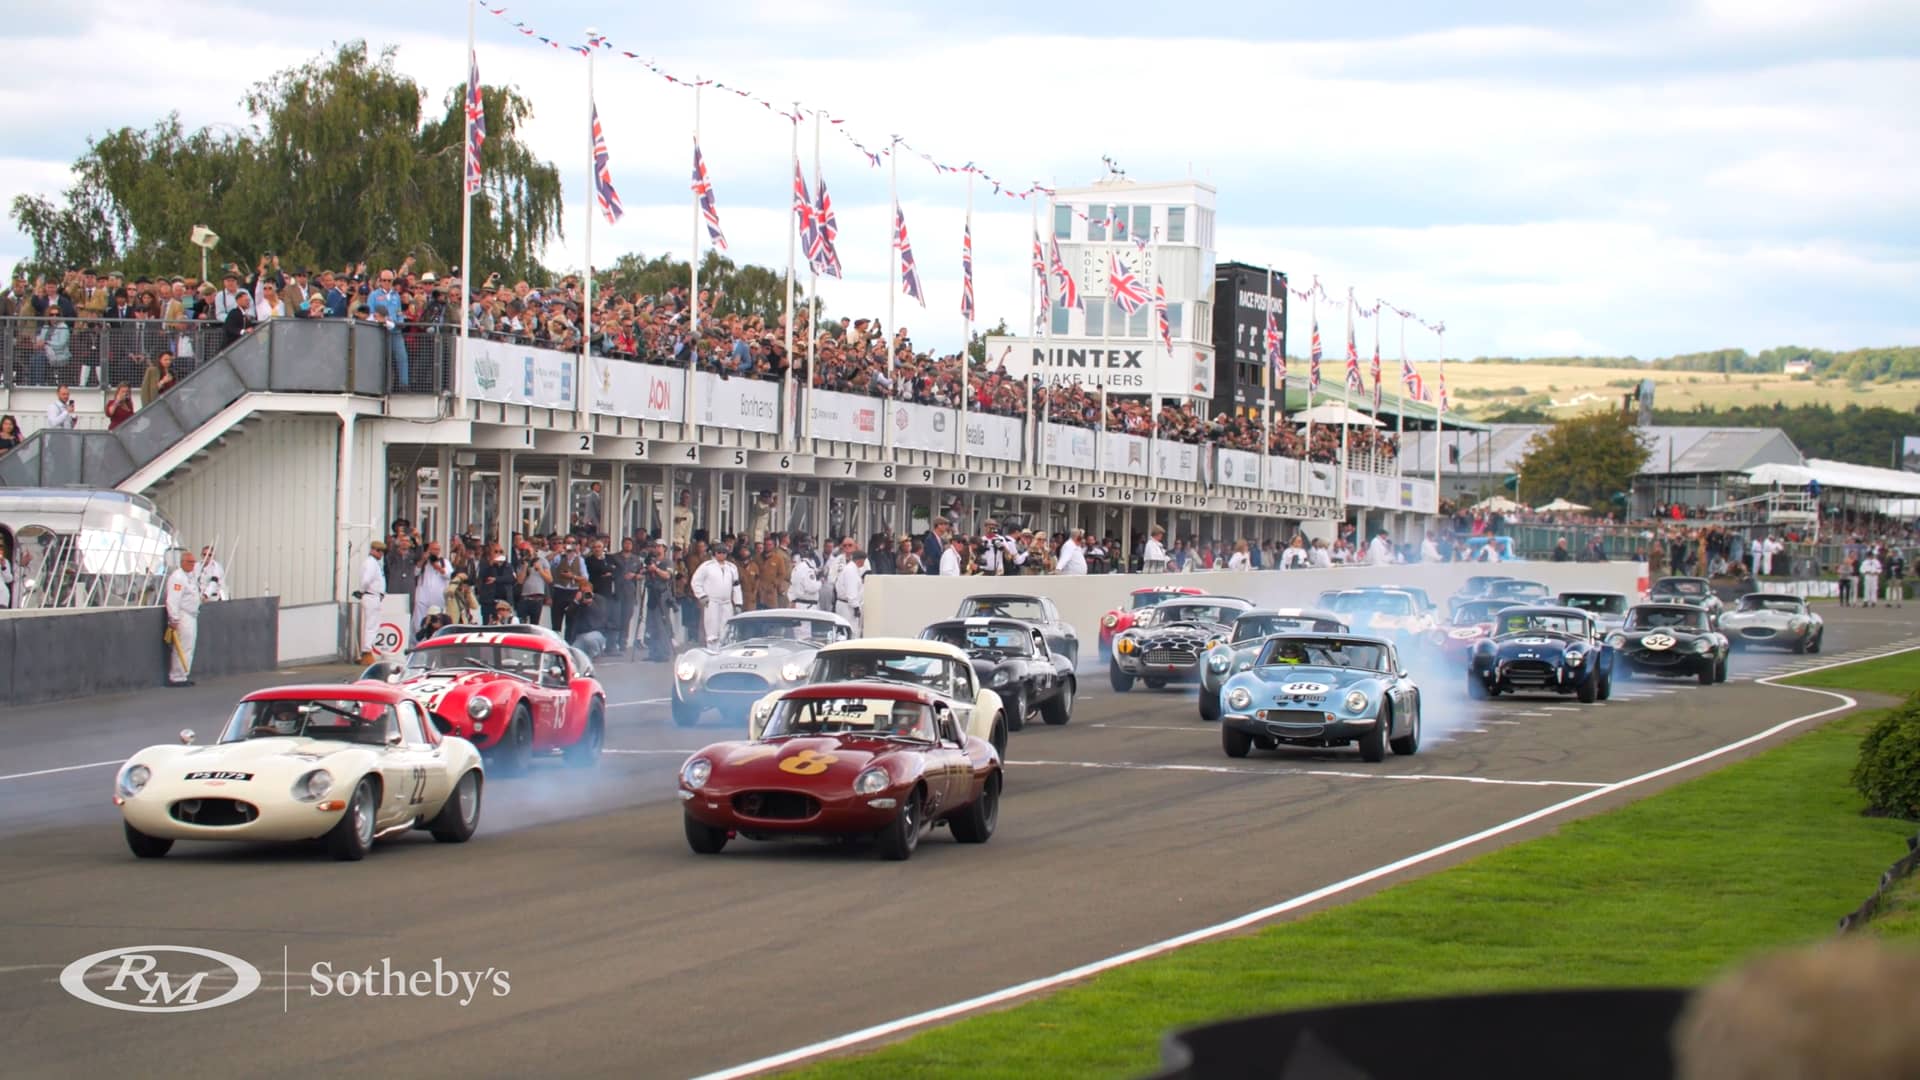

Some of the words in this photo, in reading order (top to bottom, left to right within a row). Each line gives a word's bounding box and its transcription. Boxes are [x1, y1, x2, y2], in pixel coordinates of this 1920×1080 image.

[647, 375, 672, 411] AON
[525, 429, 531, 445] 1
[579, 435, 591, 451] 2
[634, 441, 645, 456] 3
[686, 446, 697, 460] 4
[734, 451, 744, 465] 5
[780, 455, 790, 469] 6
[844, 461, 853, 475] 7
[883, 465, 893, 478] 8
[922, 469, 931, 481] 9
[951, 473, 966, 485] 10
[987, 476, 1000, 488] 11
[1017, 479, 1032, 491] 12
[1062, 484, 1076, 495] 14
[1091, 486, 1105, 498] 15
[1118, 489, 1132, 500] 16
[1144, 491, 1157, 502] 17
[1169, 494, 1182, 505] 18
[1193, 496, 1206, 507] 19
[1234, 501, 1248, 511] 20
[1257, 503, 1269, 513] 21
[1275, 504, 1289, 515] 22
[1295, 506, 1308, 517] 23
[374, 632, 398, 647] 20
[779, 749, 840, 775] 8
[408, 766, 427, 806] 22
